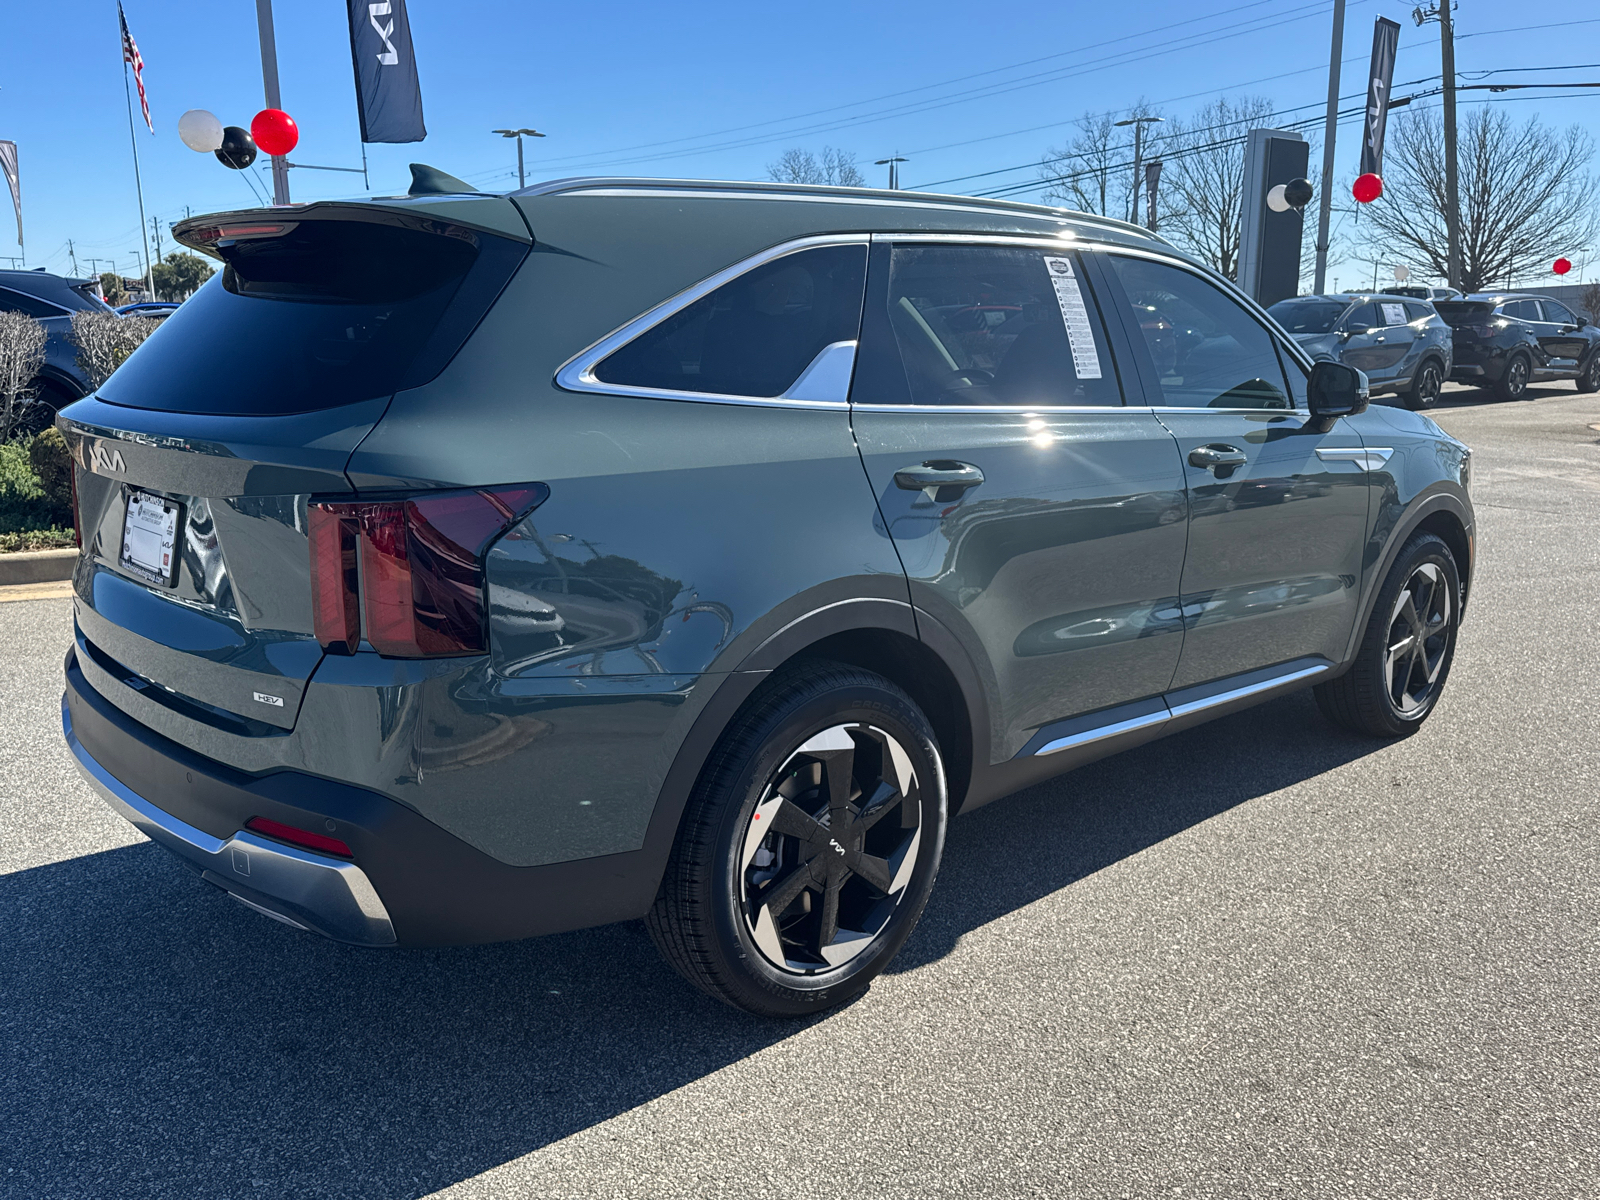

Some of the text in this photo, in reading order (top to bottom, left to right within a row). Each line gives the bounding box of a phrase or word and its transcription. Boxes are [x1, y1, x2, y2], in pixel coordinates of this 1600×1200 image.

[368, 0, 398, 65] KI
[1367, 78, 1385, 147] KIA
[88, 444, 126, 473] KIA
[162, 541, 174, 549] KIA
[258, 694, 279, 704] HEV
[829, 838, 846, 856] KIA
